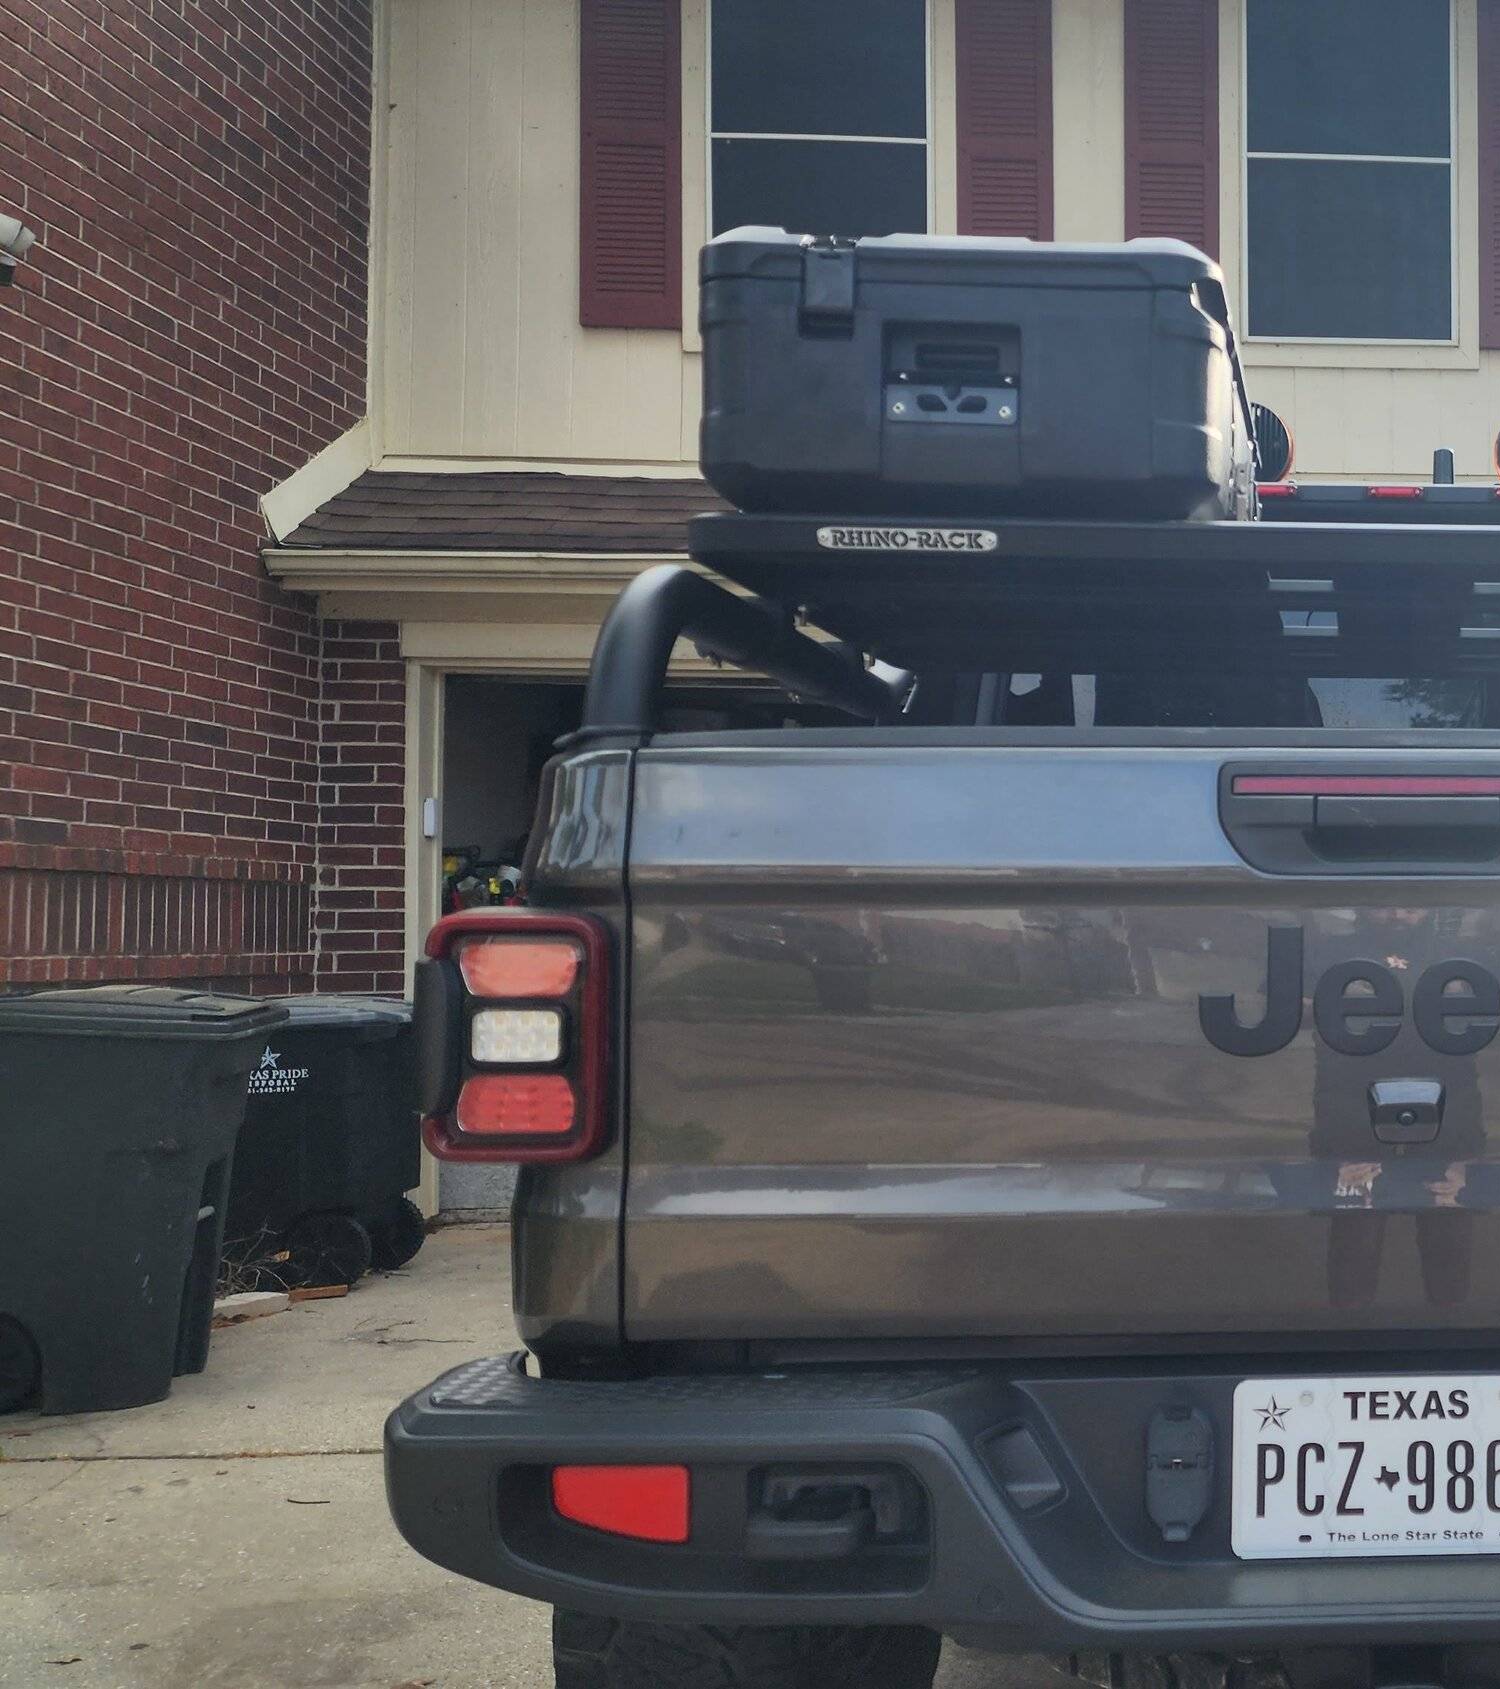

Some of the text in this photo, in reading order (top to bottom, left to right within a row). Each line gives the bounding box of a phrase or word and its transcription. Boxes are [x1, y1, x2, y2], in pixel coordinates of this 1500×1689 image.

[830, 529, 984, 549] RHINO-RACK
[271, 1068, 309, 1079] PRIDE
[248, 1079, 297, 1087] ISPOSAL
[1343, 1389, 1470, 1421] TEXAS
[1256, 1441, 1365, 1518] PCZ
[1327, 1530, 1484, 1543] The Lone Star State
